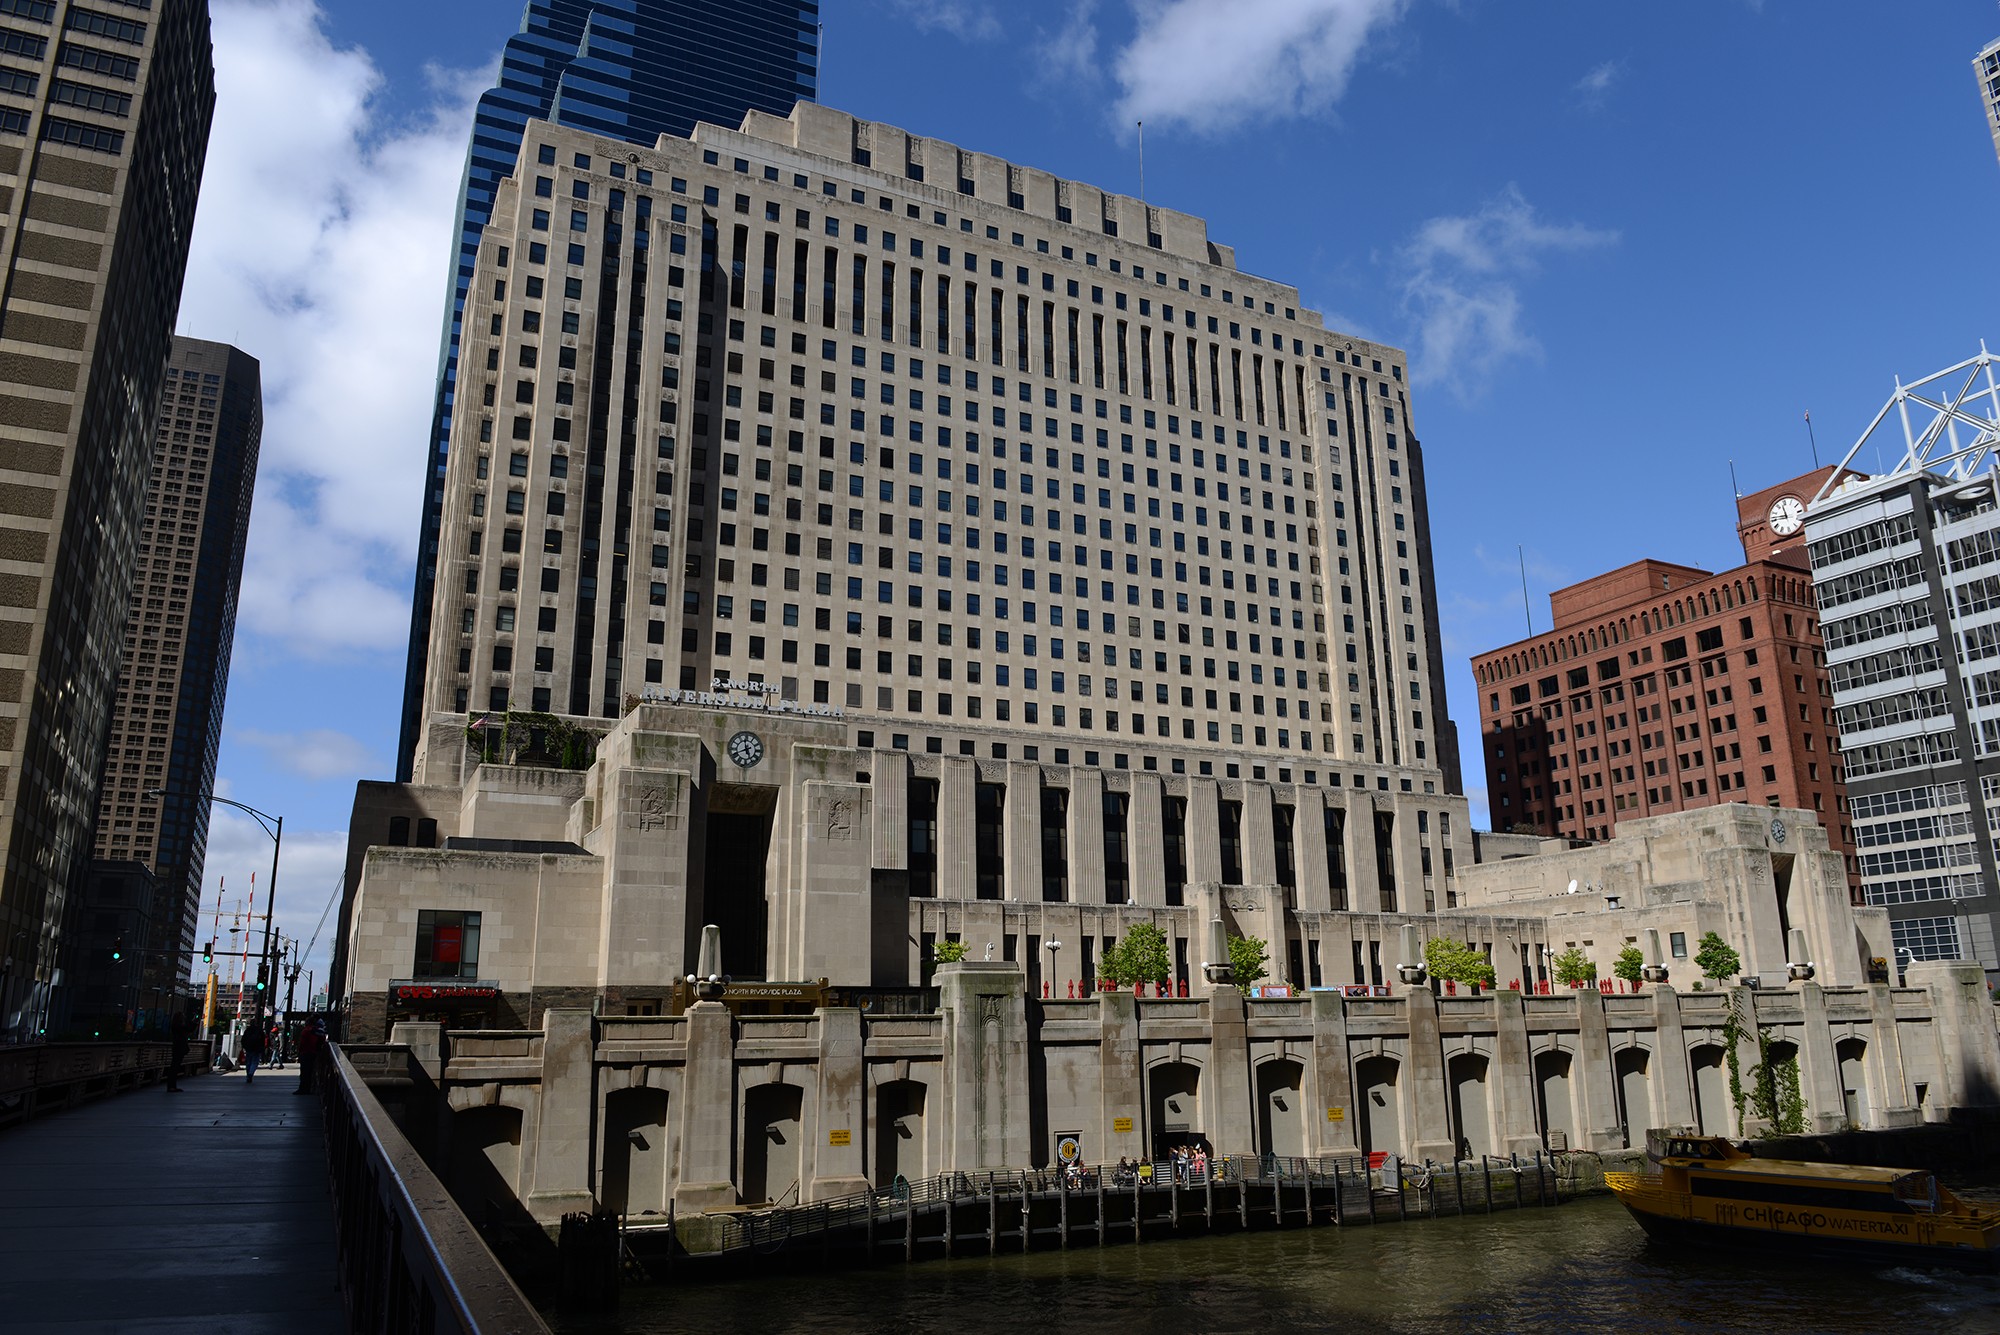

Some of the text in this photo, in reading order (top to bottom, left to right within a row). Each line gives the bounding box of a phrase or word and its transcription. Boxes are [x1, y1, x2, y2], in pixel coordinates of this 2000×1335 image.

[711, 677, 780, 692] 2 NORTH
[641, 686, 844, 717] RIVERSIDE PLAZA
[750, 988, 780, 996] RIVERSIDE
[1743, 1206, 1827, 1228] CHICAGO
